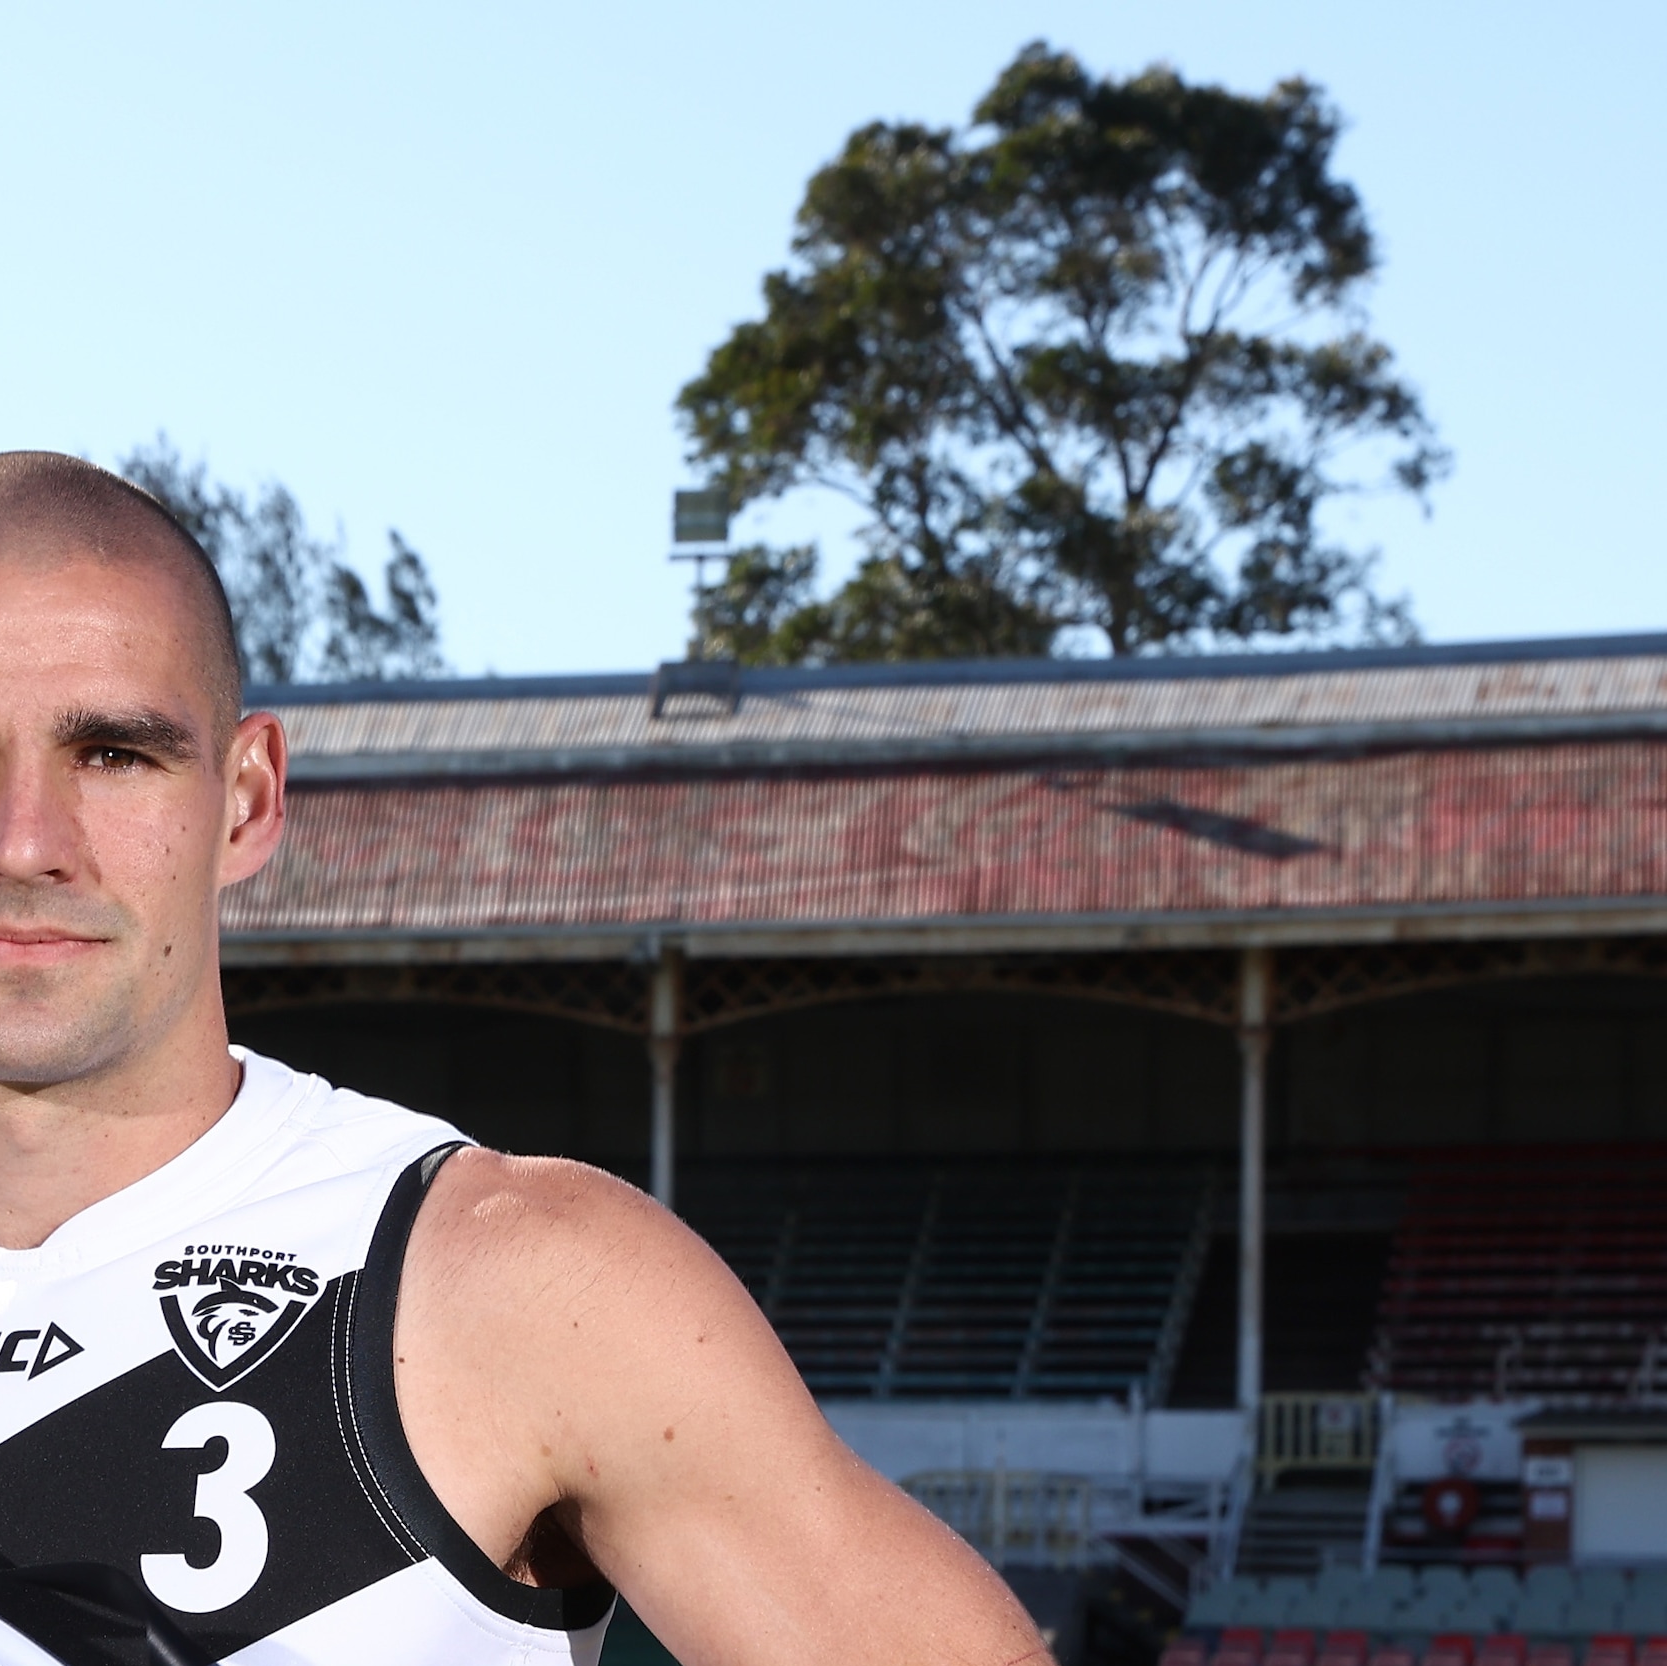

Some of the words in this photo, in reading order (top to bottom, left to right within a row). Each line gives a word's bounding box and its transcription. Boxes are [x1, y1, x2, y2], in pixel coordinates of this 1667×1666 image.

[184, 1245, 298, 1262] SOUTHPORT
[152, 1258, 320, 1297] SHARKS
[139, 1400, 277, 1614] 3
